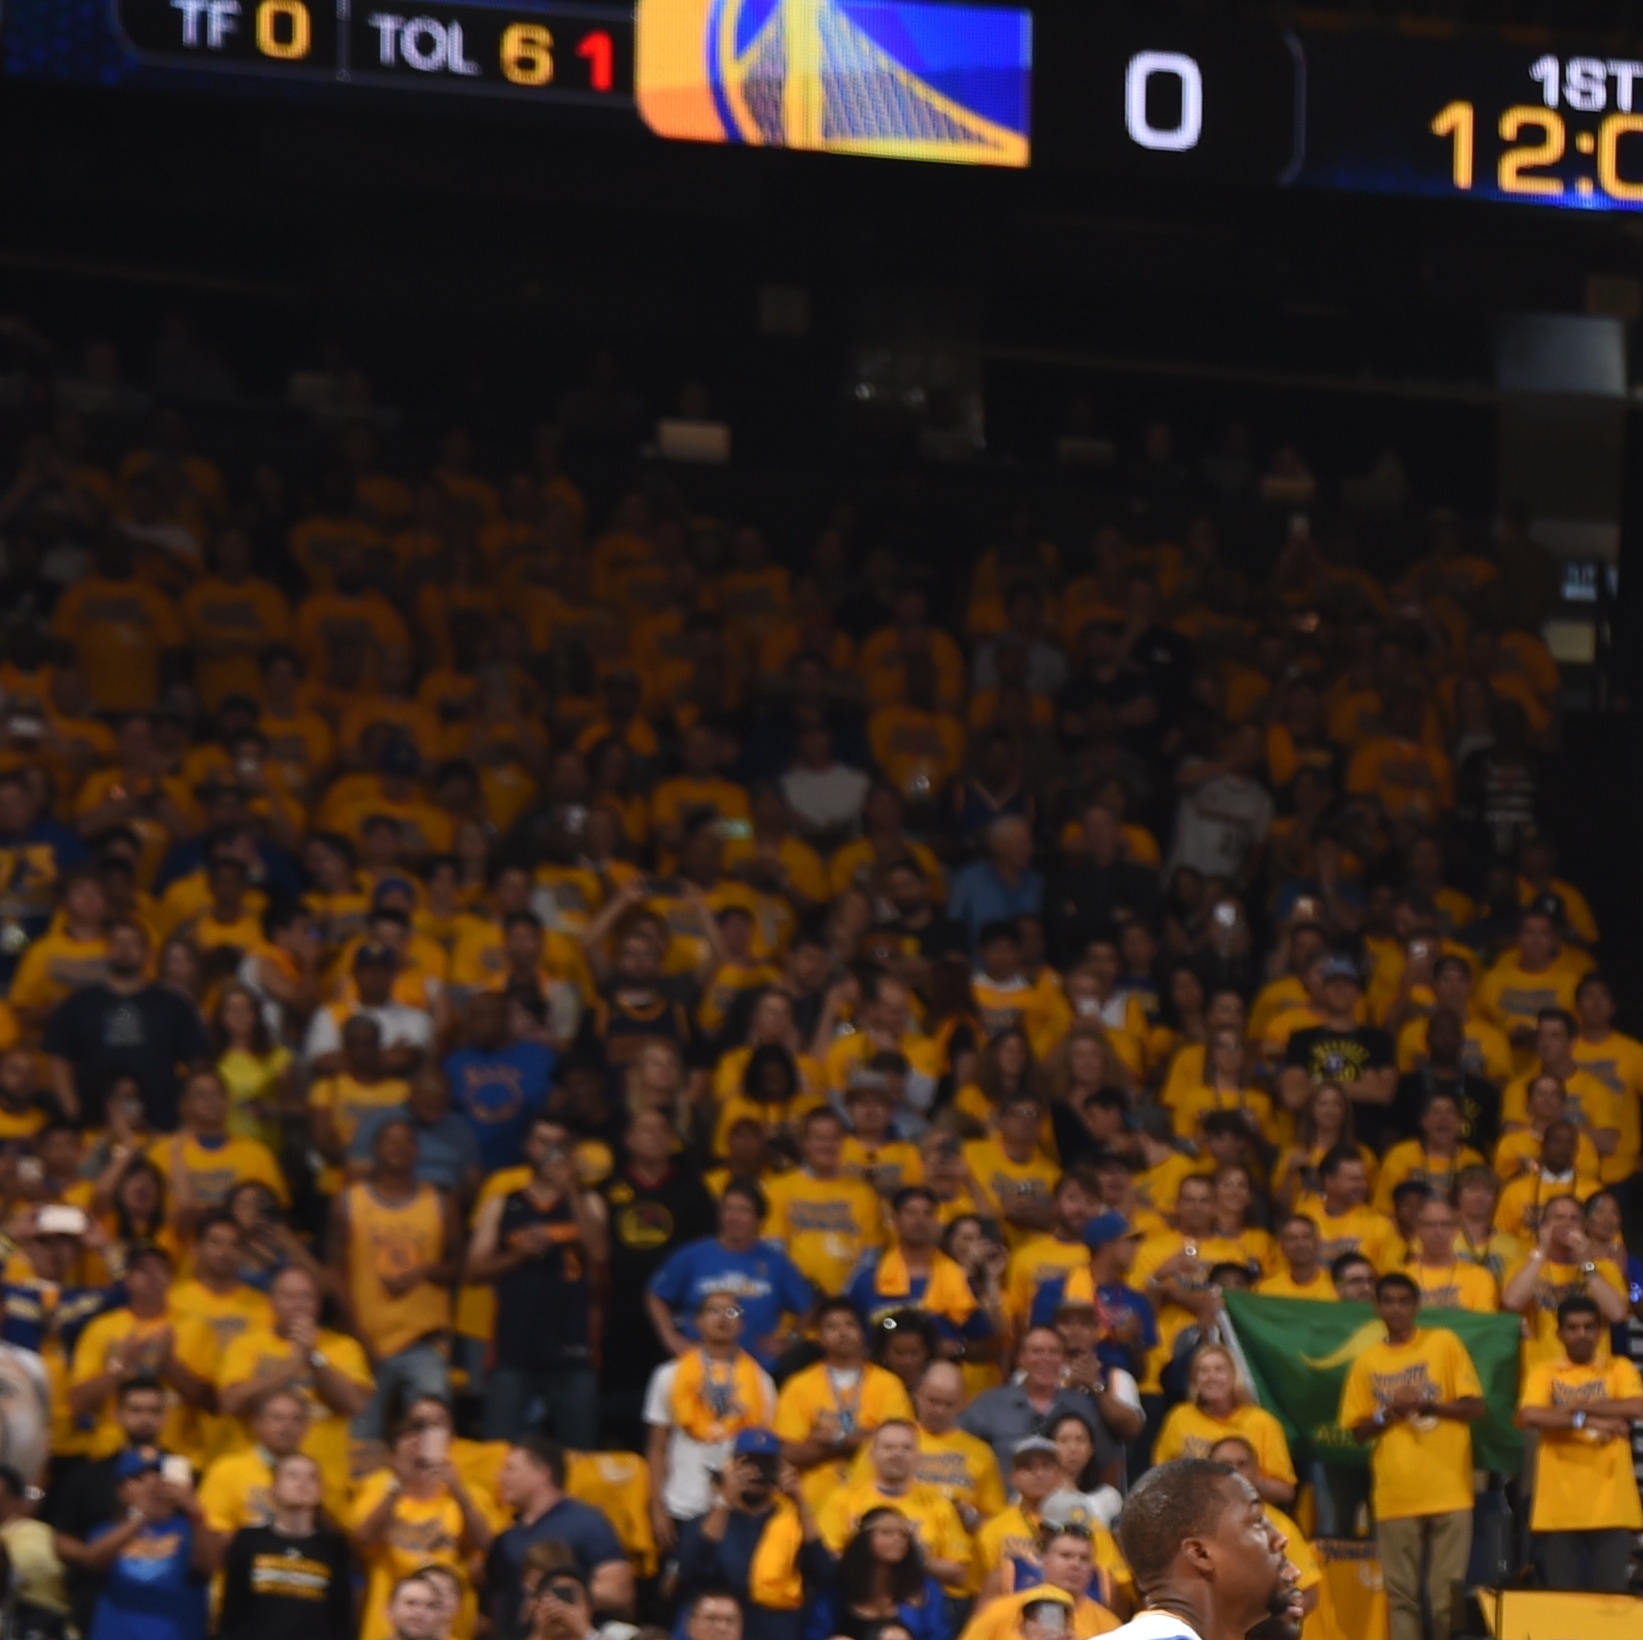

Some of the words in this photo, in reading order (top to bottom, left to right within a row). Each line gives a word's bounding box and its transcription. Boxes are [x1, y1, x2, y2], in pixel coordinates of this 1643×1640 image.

[171, 0, 237, 48] TF
[256, 0, 310, 58] 0
[368, 13, 478, 77] TOL
[500, 23, 555, 86] 6
[576, 31, 615, 92] 1
[1124, 51, 1204, 152] 0
